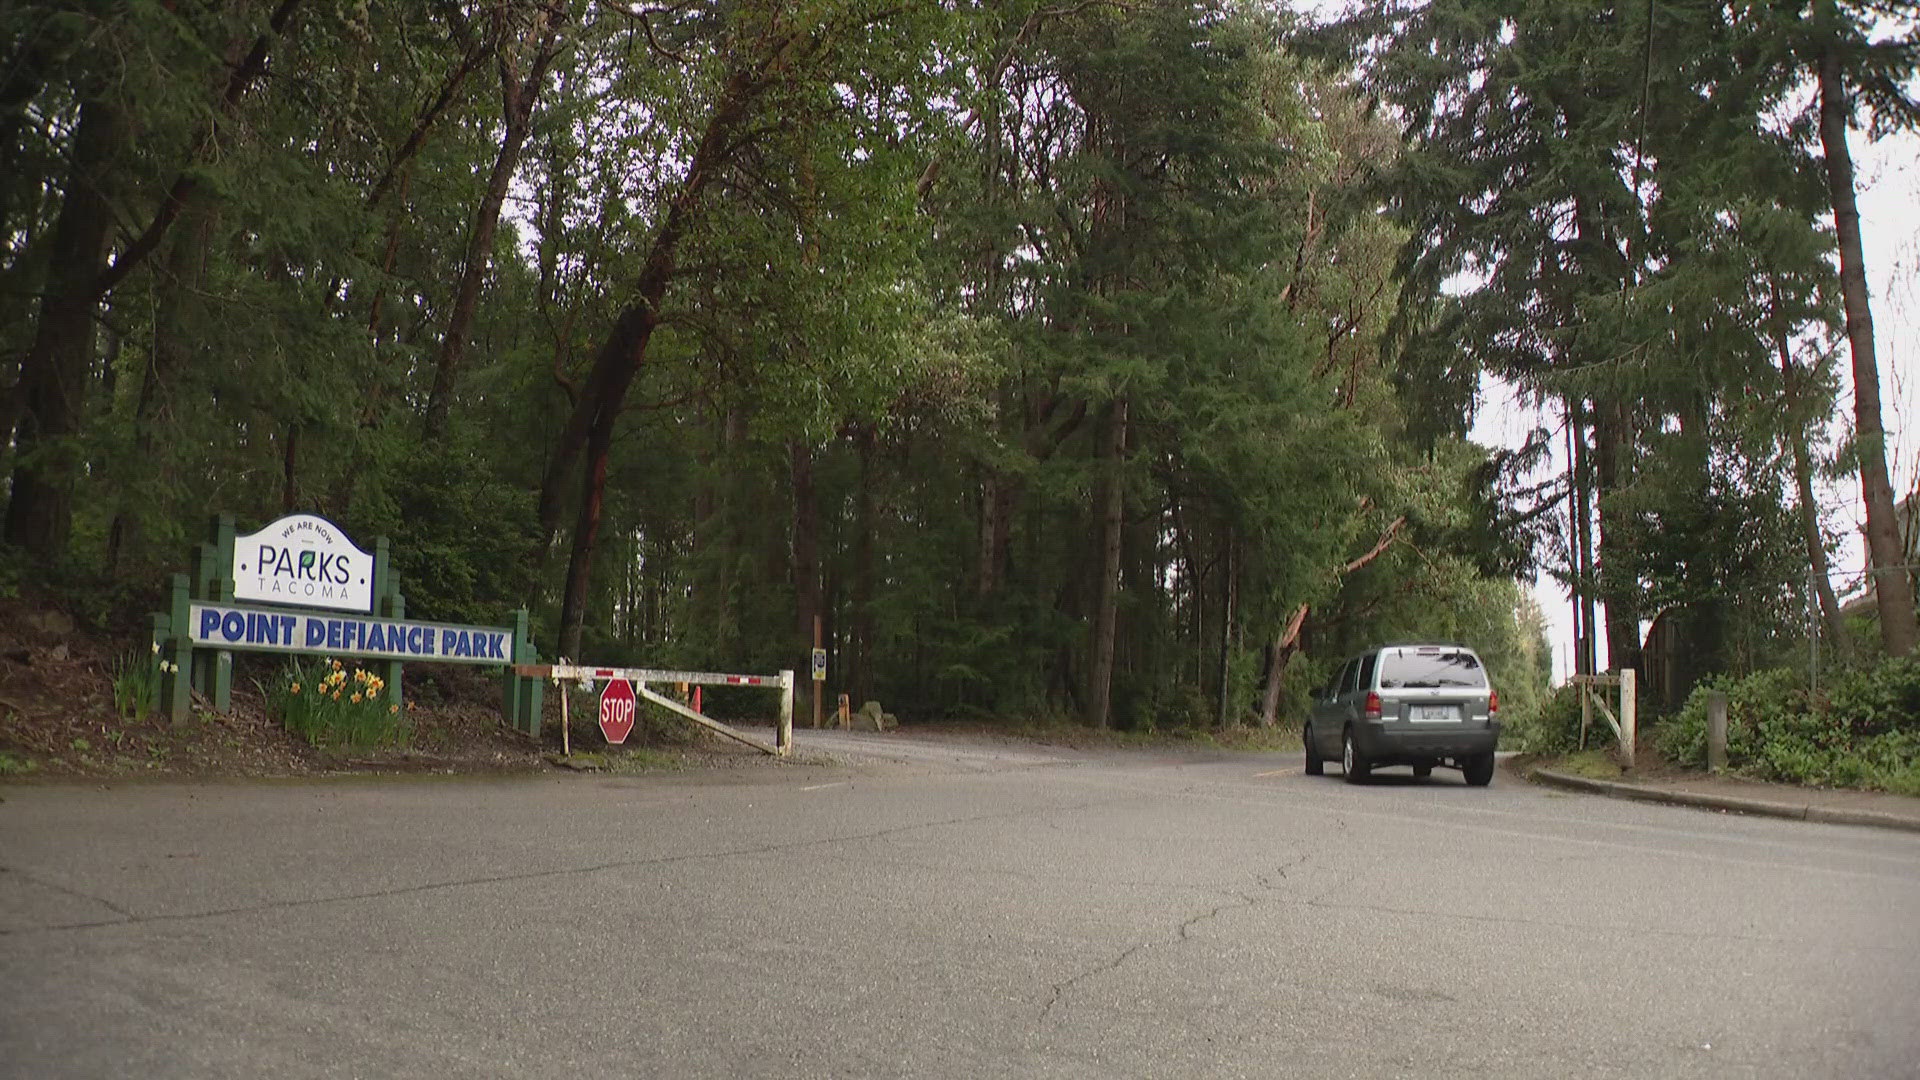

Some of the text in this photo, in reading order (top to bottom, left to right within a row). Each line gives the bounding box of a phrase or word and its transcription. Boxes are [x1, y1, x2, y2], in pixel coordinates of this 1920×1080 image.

[282, 521, 333, 545] WE ARE NOW
[258, 544, 350, 585] PARKS
[258, 578, 349, 600] TACOMA
[200, 608, 504, 660] POINT DEFIANCE PARK
[602, 697, 633, 723] STOP
